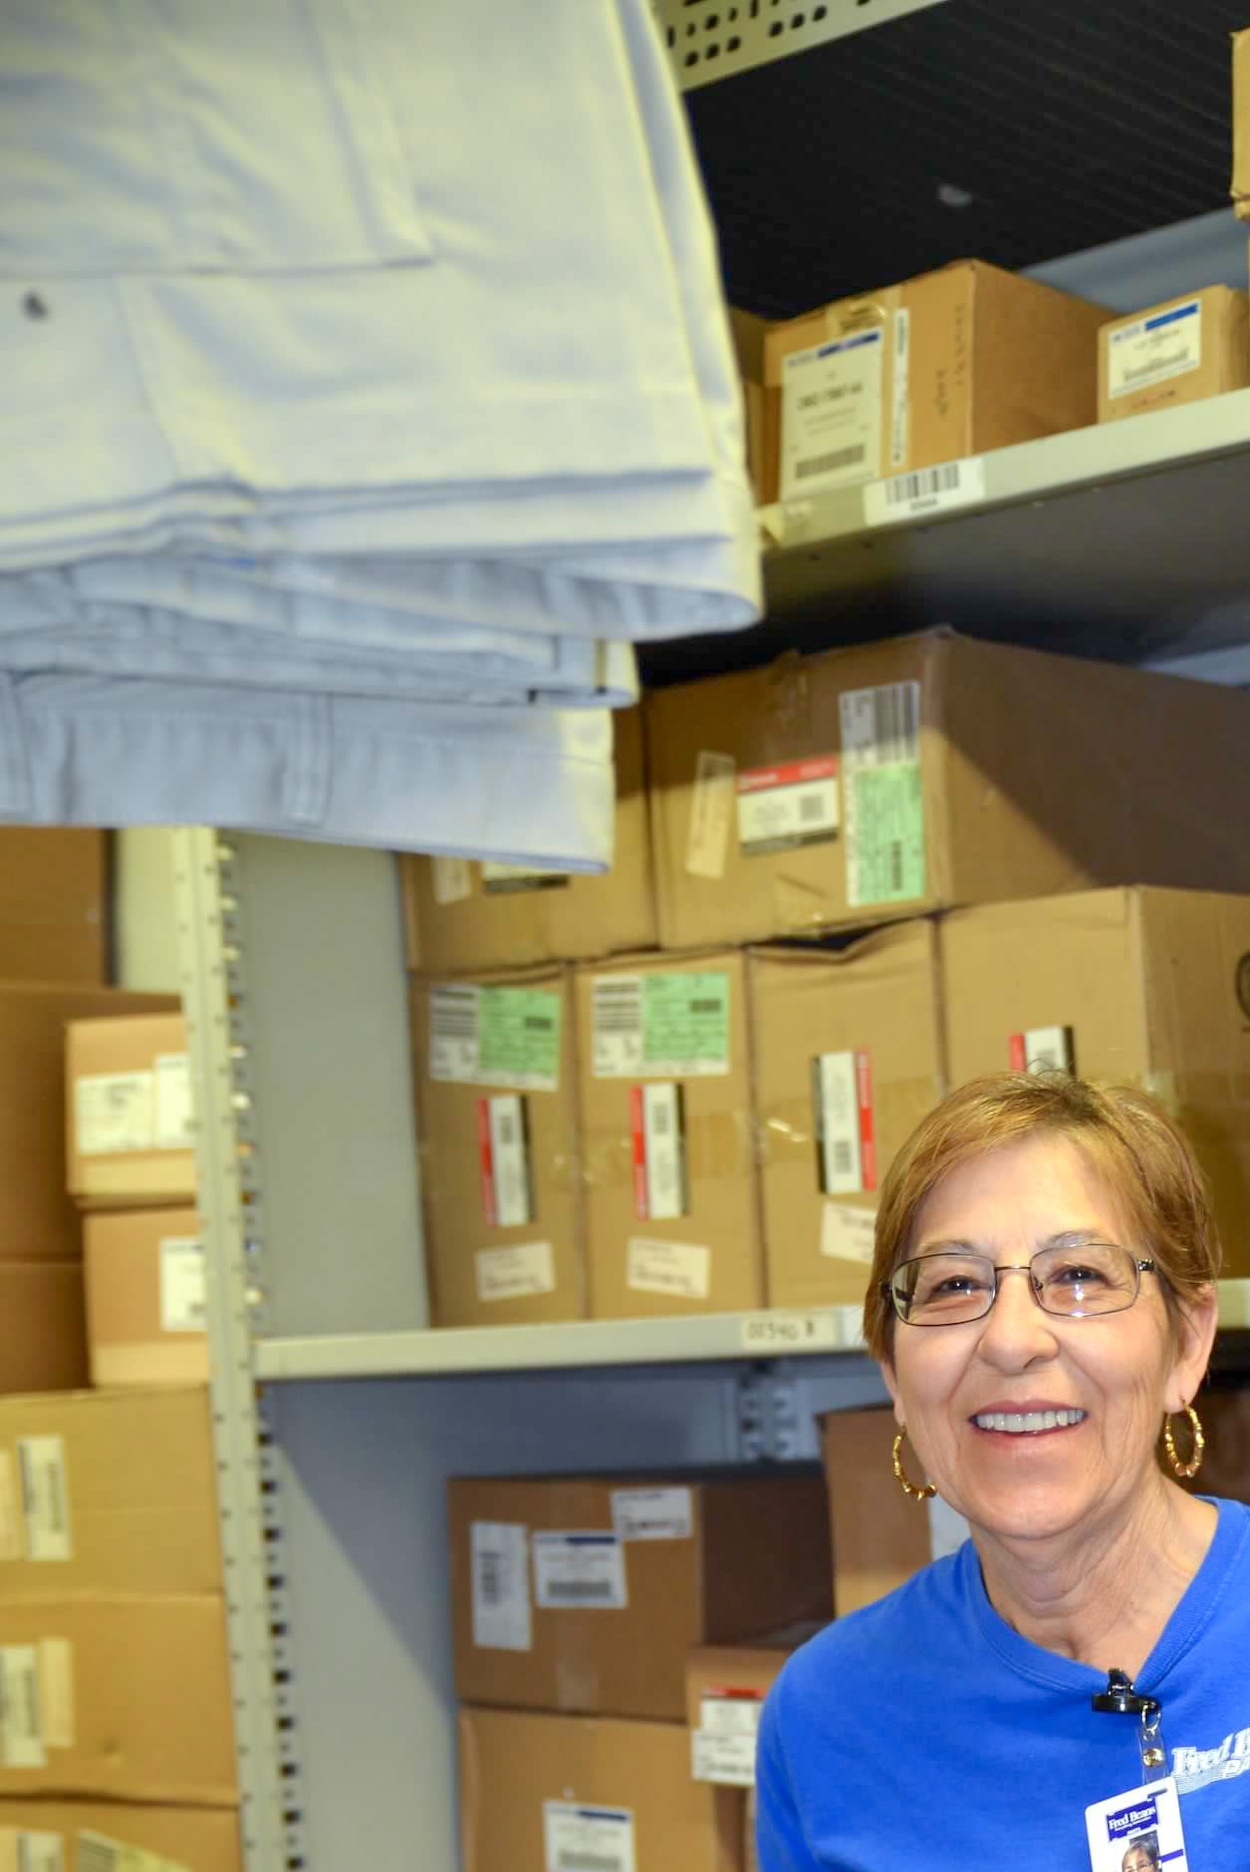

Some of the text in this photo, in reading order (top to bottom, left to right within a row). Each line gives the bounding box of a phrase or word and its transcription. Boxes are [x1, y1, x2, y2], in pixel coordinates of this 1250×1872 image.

[1171, 1733, 1234, 1776] Fred
[1109, 1814, 1129, 1829] Fred
[1129, 1807, 1156, 1823] Beans
